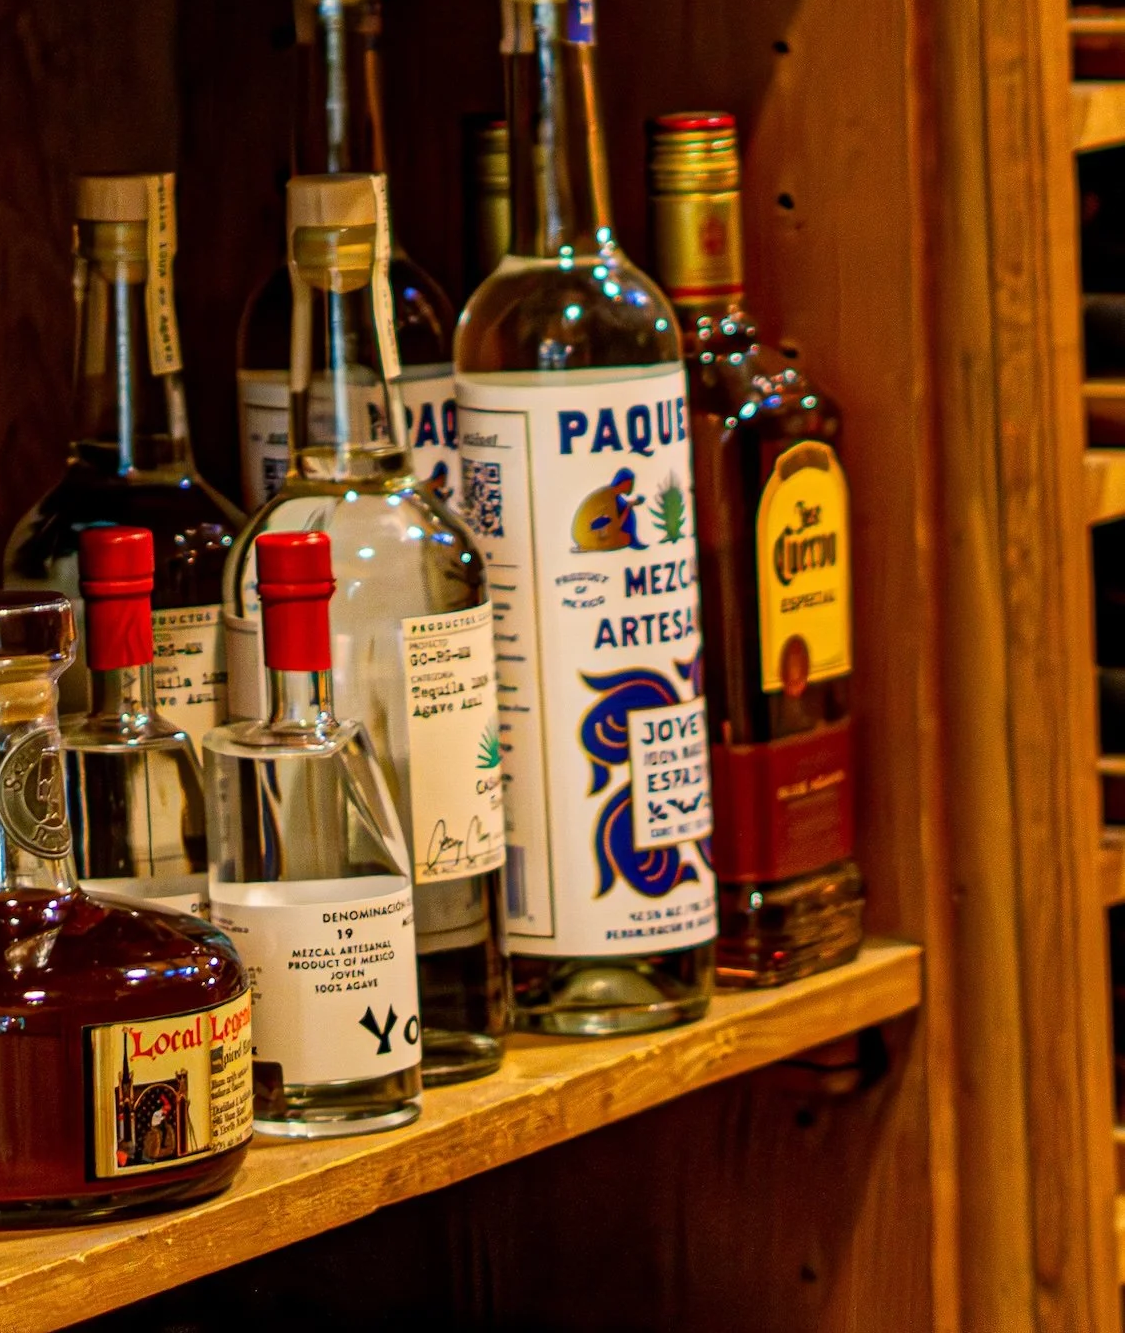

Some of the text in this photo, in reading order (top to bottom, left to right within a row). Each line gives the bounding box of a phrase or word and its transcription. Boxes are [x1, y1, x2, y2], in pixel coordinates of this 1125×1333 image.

[624, 559, 698, 598] MEZC
[411, 681, 465, 700] Tequila
[412, 702, 454, 719] Agave
[640, 712, 704, 745] JOVE
[336, 927, 354, 940] 19
[291, 939, 392, 959] MEZCAL ARTESANAL
[288, 950, 395, 970] PRODUCT MEXICO
[330, 968, 365, 981] JOVEN
[315, 978, 379, 994] 100% AGAVE
[128, 1016, 202, 1062] Local
